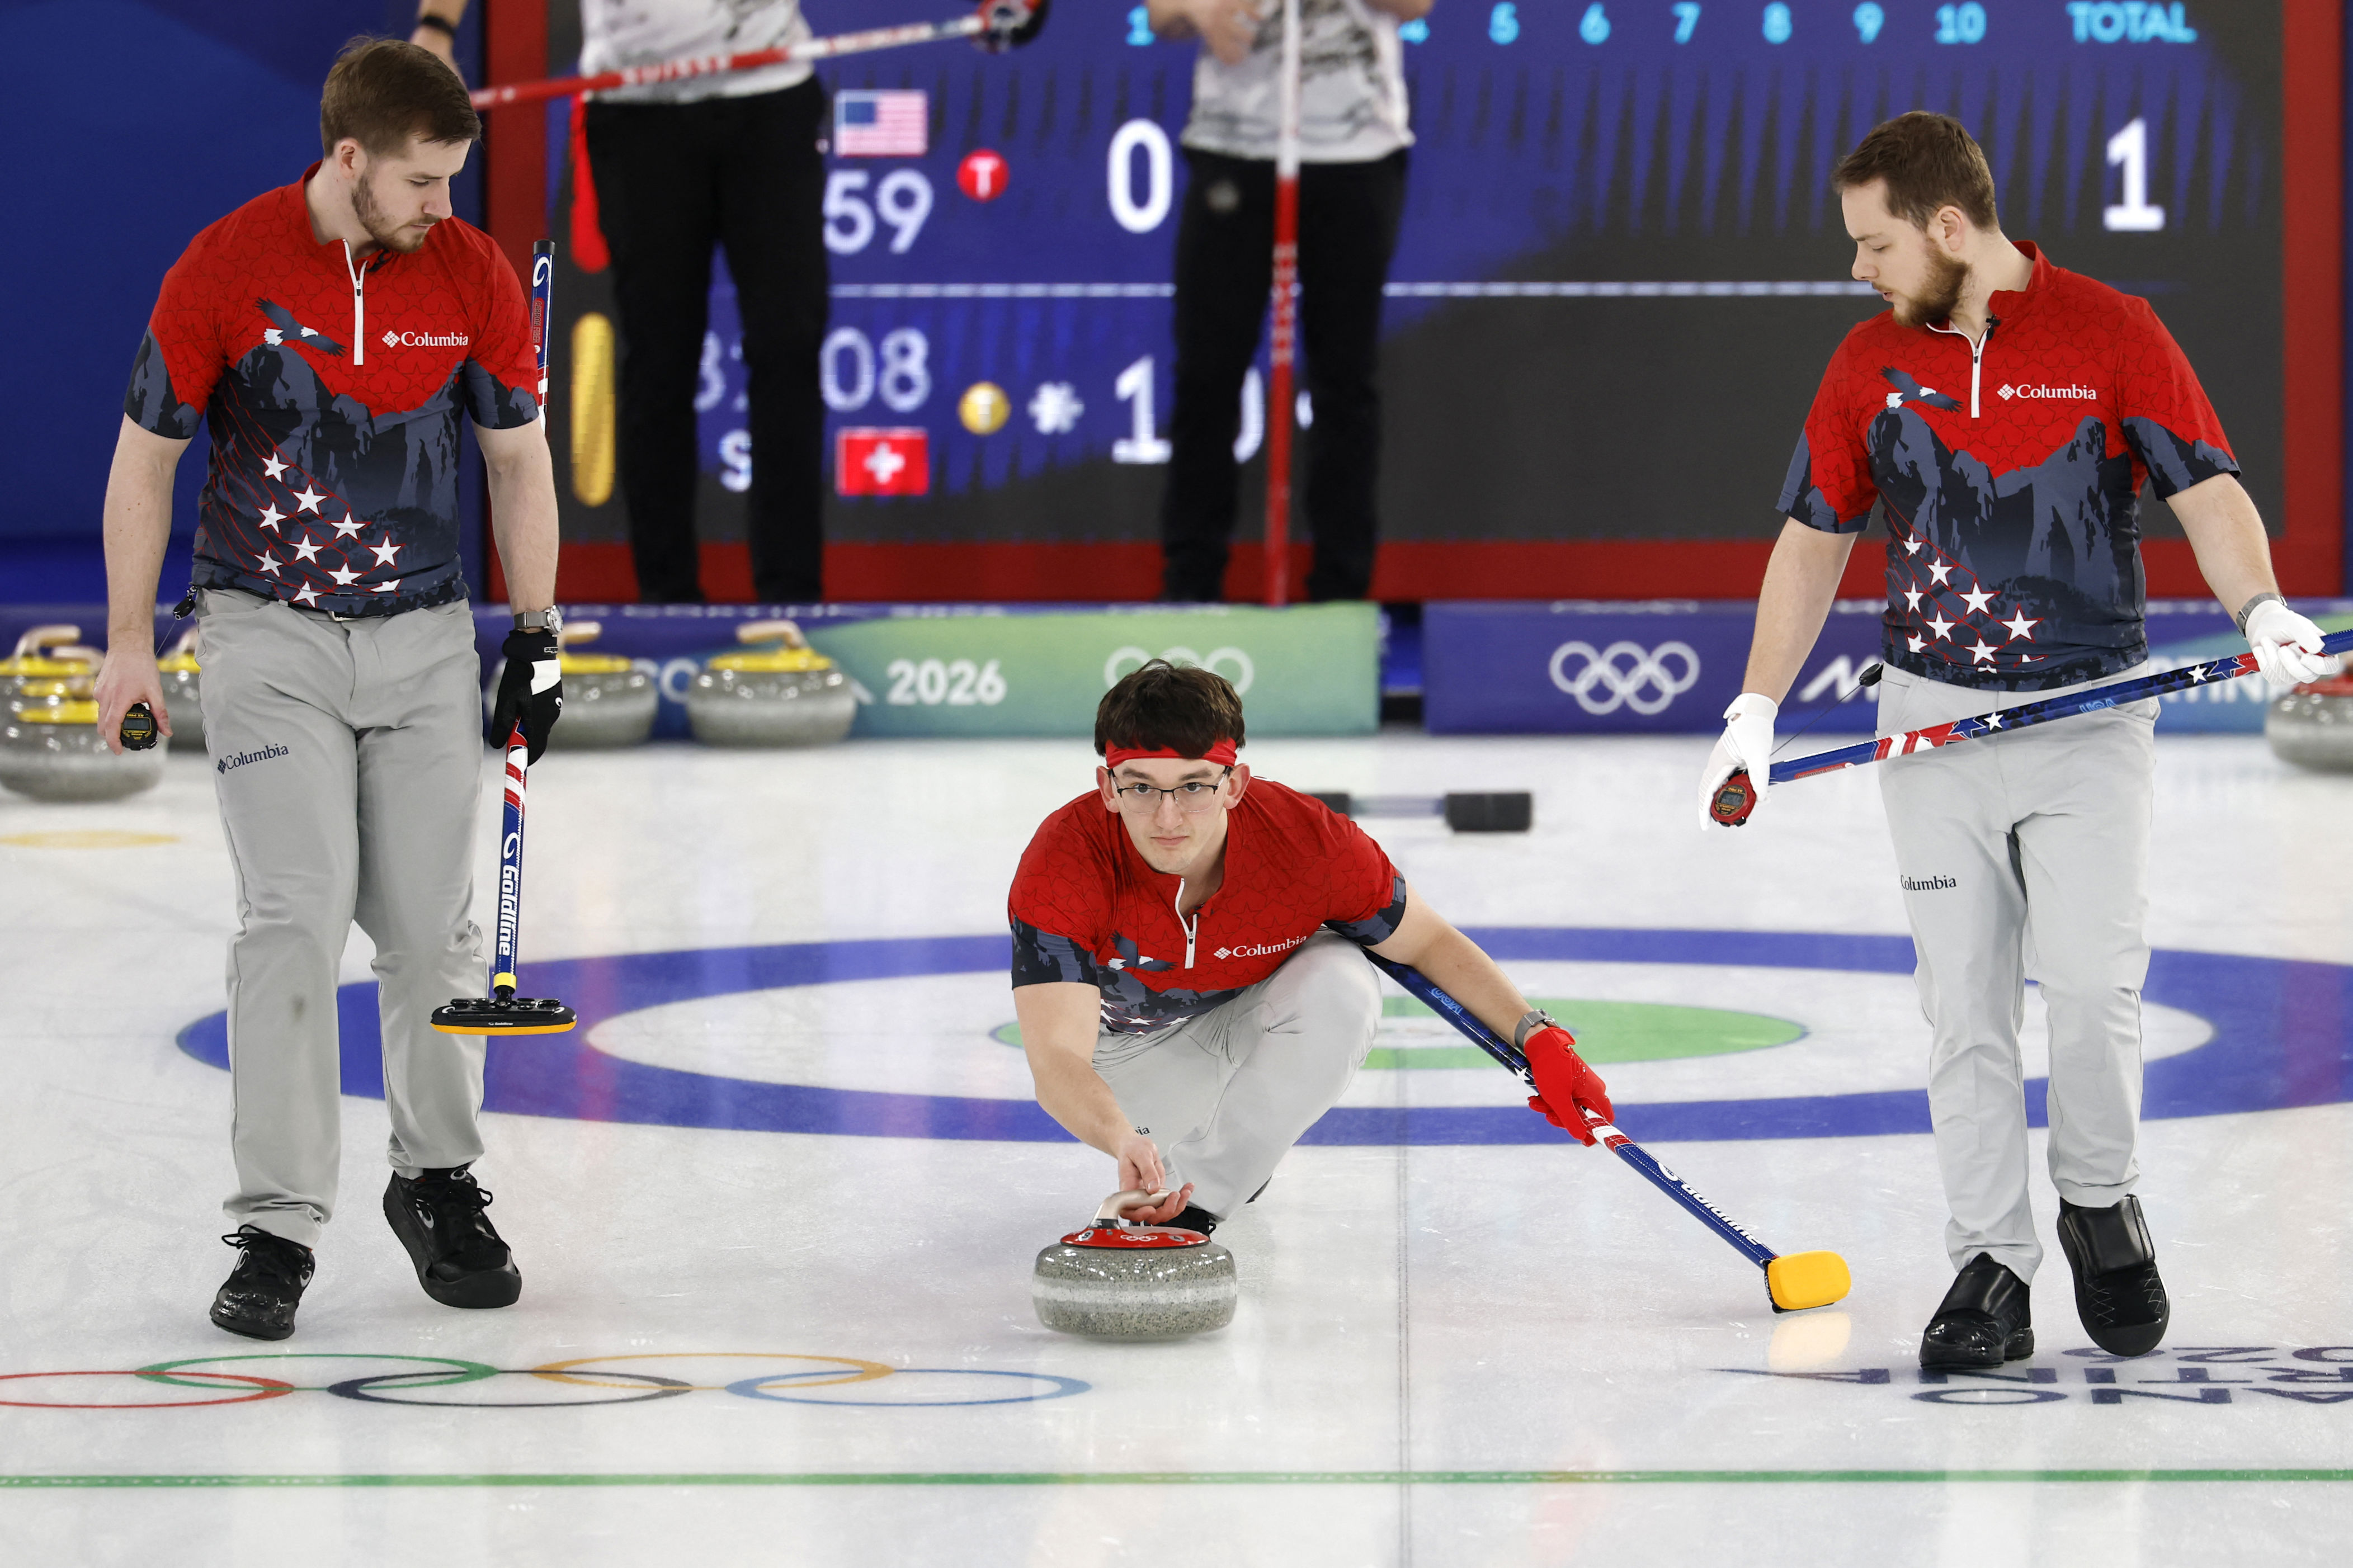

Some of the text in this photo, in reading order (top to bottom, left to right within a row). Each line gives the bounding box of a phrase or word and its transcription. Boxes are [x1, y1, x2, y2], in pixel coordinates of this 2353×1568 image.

[1488, 2, 1520, 45] 5
[1579, 2, 1611, 45] 6
[1671, 2, 1701, 44] 7
[1762, 2, 1793, 45] 8
[1854, 1, 1884, 44] 9
[1935, 2, 1987, 44] 10
[2066, 1, 2197, 44] TOTAL
[970, 156, 1000, 197] T
[1107, 118, 1173, 234] 0
[2102, 116, 2165, 232] 1
[400, 331, 469, 347] Columbia
[2016, 384, 2097, 400] Columbia
[886, 658, 1008, 706] 2026
[225, 743, 289, 770] Columbia
[1901, 875, 1957, 891] Columbia
[498, 865, 519, 957] Goldline
[1232, 936, 1308, 957] Columbia
[1431, 988, 1464, 1014] USA
